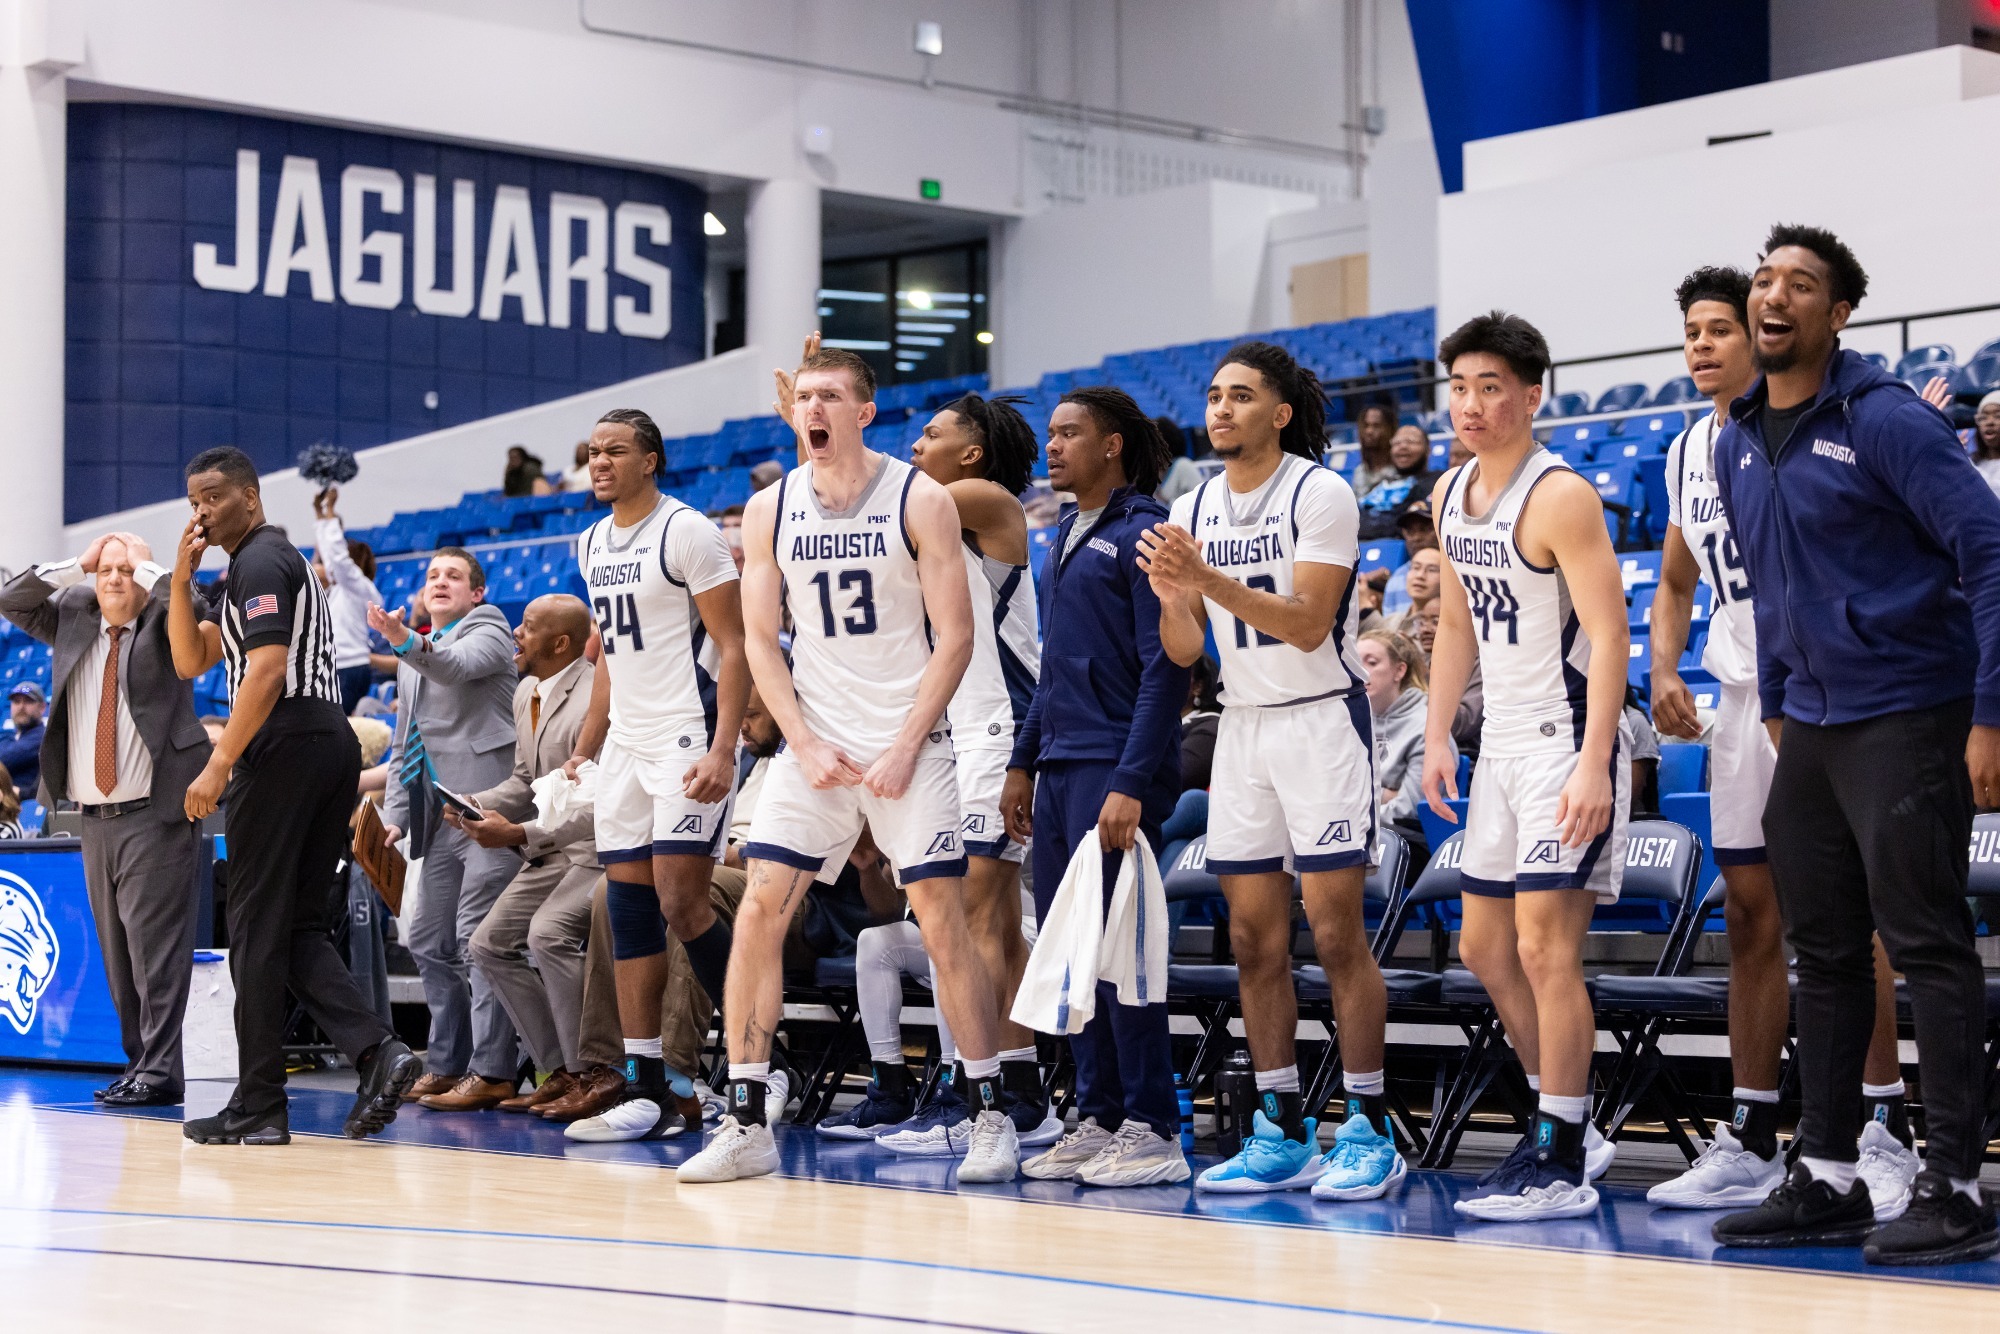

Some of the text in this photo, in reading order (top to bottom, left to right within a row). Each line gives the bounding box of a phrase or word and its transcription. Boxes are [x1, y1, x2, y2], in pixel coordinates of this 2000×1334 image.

[193, 149, 671, 339] JAGUARS
[1811, 438, 1857, 466] AUGUSTA
[867, 514, 891, 524] PBC
[1495, 521, 1512, 531] PBC
[791, 531, 887, 562] AUGUSTA
[1086, 536, 1119, 559] AUGUSTA
[1206, 532, 1284, 568] AUGUSTA
[1445, 534, 1512, 569] AUGUSTA
[589, 561, 642, 588] AUGUSTA
[808, 567, 879, 639] 13
[1461, 573, 1520, 646] 44
[593, 592, 645, 655] 24
